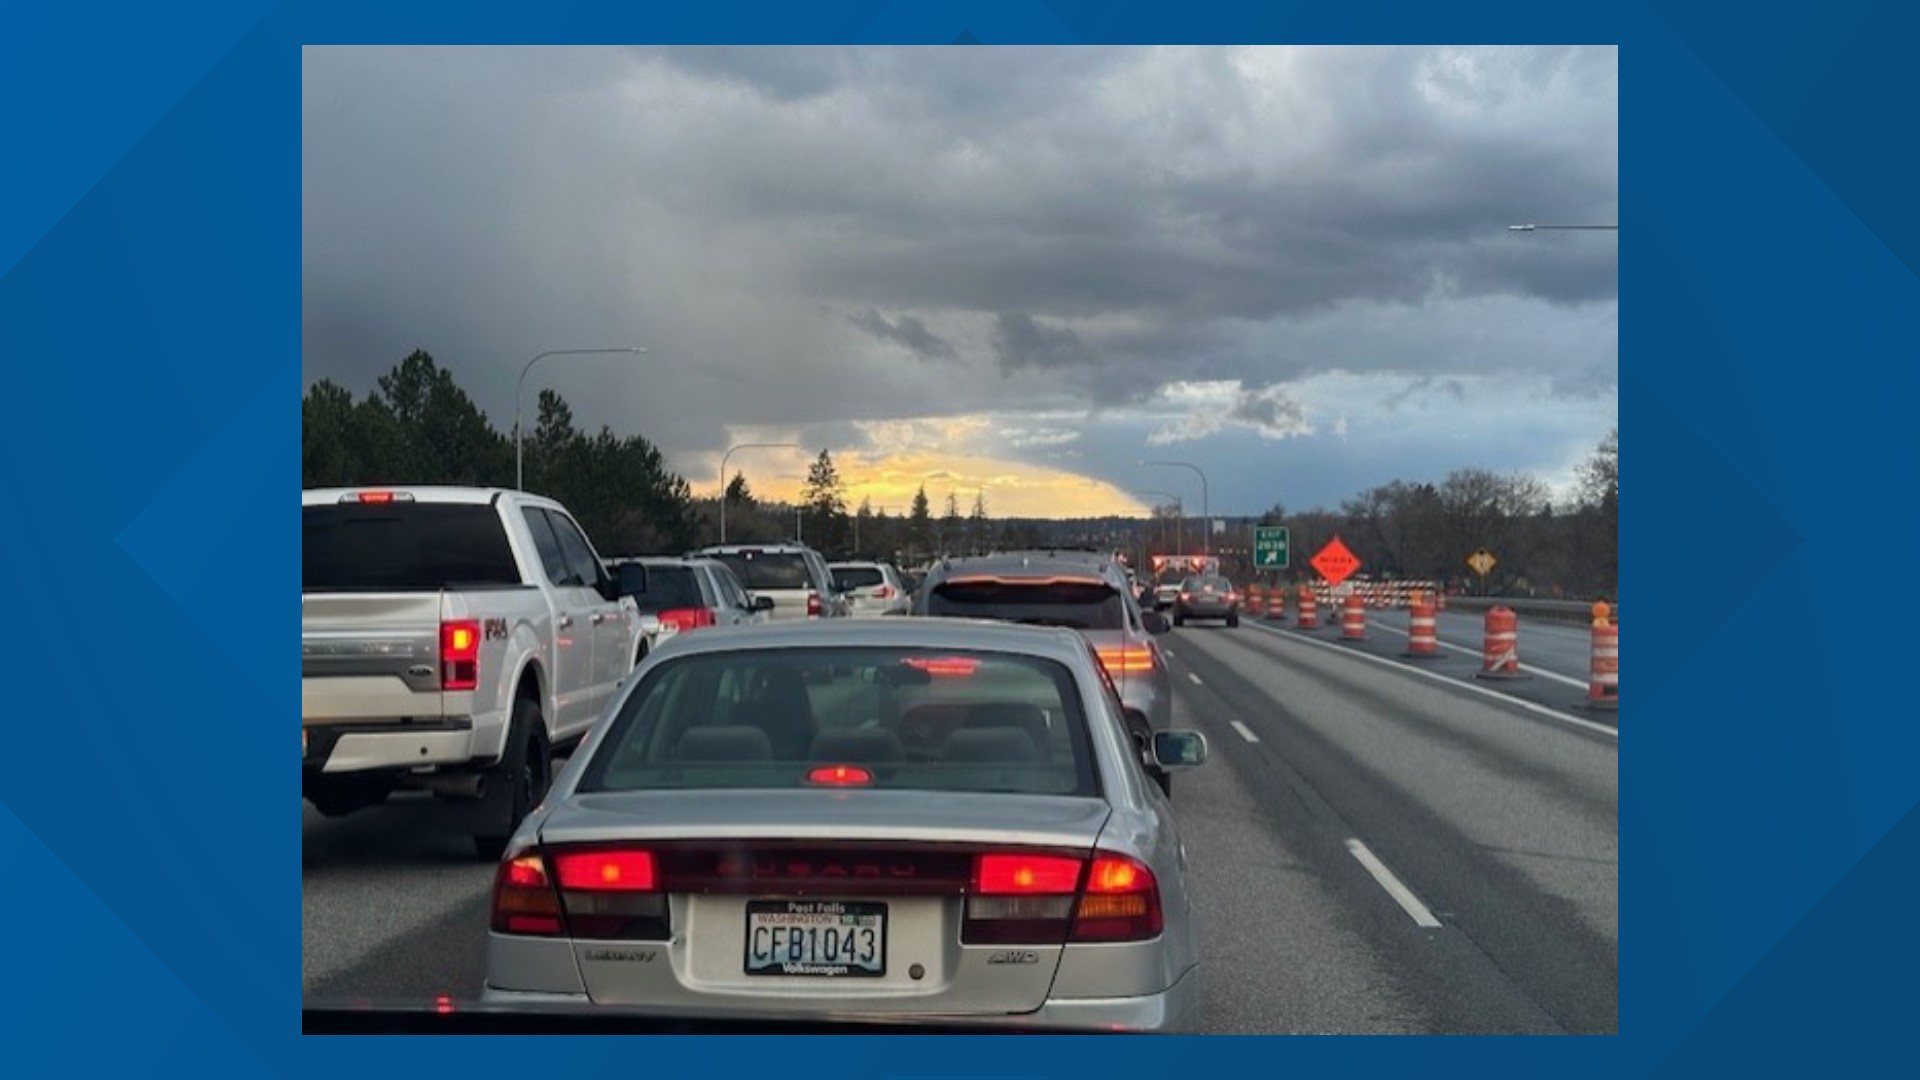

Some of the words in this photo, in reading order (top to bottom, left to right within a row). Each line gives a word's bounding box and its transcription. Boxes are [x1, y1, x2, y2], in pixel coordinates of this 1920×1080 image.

[758, 914, 833, 924] WASHINGTON
[753, 926, 875, 963] CFB1043
[986, 951, 1040, 964] AWD
[782, 963, 848, 976] Volkswagen
